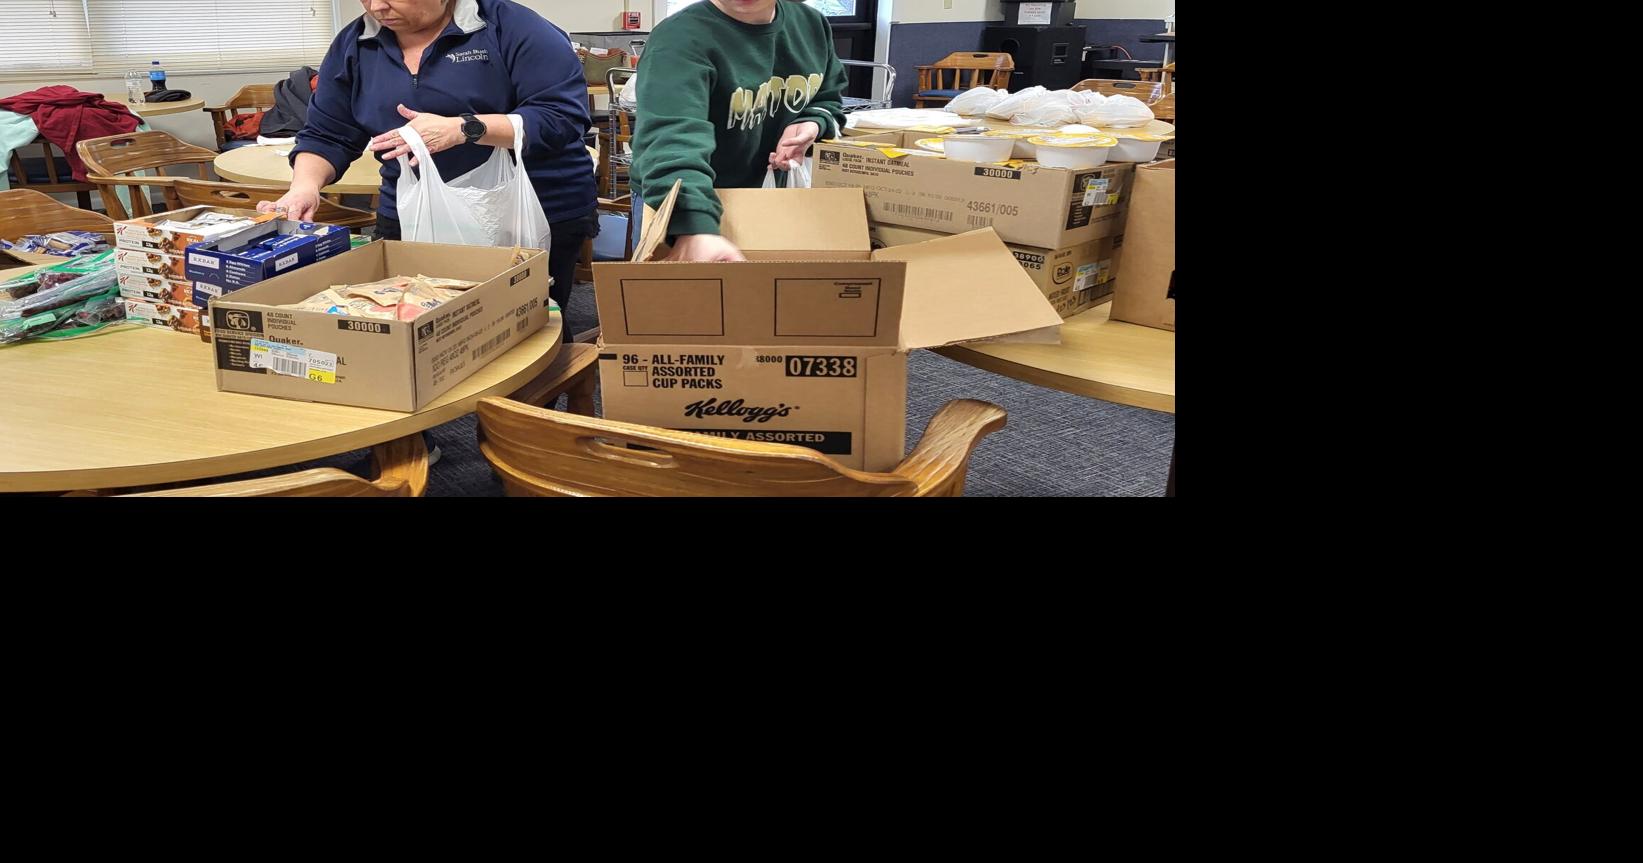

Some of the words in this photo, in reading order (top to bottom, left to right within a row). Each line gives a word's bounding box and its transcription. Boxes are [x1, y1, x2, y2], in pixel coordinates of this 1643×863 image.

[456, 54, 488, 62] Lincoln
[983, 168, 1013, 178] 30000
[967, 201, 1019, 216] 43661/005
[348, 321, 381, 333] 30000
[269, 335, 300, 344] Quaker
[623, 354, 639, 364] 96
[652, 355, 725, 365] ALL-FAMILY
[790, 357, 855, 376] 07338
[652, 367, 715, 377] ASSORTED
[653, 379, 677, 389] CUP
[682, 379, 722, 389] PACKS
[685, 398, 792, 423] Kellogg's
[746, 432, 825, 442] ASSORTED
